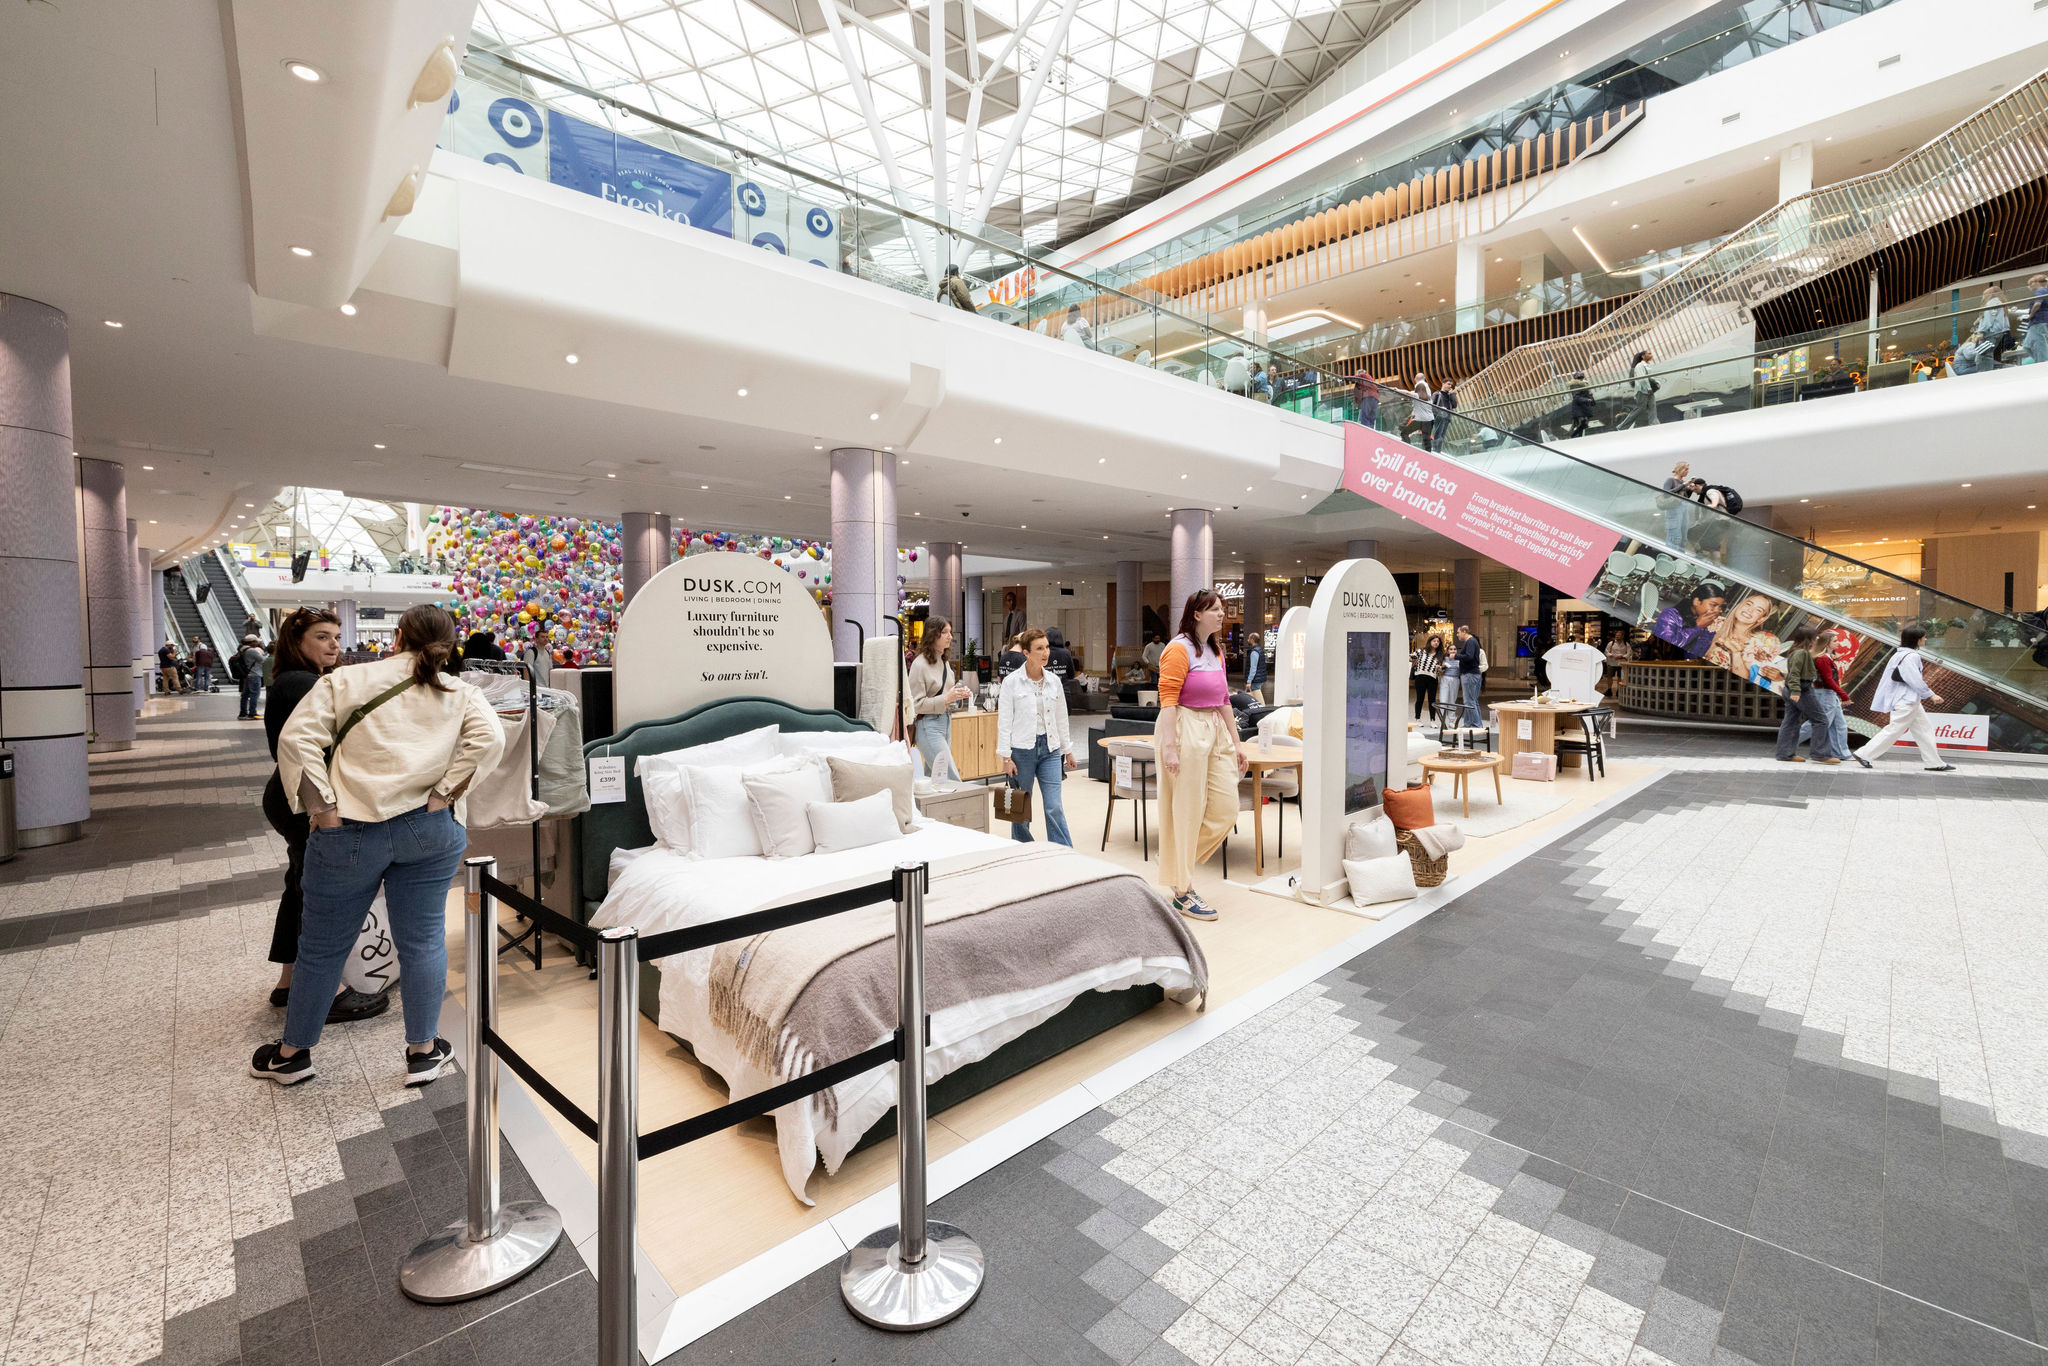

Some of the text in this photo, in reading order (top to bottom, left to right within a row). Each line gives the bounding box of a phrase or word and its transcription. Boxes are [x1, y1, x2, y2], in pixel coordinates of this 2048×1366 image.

[601, 182, 691, 227] Fresko
[1371, 447, 1458, 496] Spill the tea
[1361, 471, 1447, 520] over brunch.
[1471, 491, 1593, 550] From breakfast burritos to salt beef
[1461, 512, 1495, 532] everyone's
[1494, 526, 1513, 541] taste.
[1514, 534, 1528, 548] Get
[1527, 541, 1559, 561] together
[1558, 554, 1572, 567] IRL.
[1466, 501, 1585, 561] bagels, there's something to satisfy
[683, 578, 781, 594] DUSK.COM
[1215, 582, 1244, 599] Kieh
[1343, 591, 1395, 609] DUSK.COM
[687, 611, 779, 623] Luxury furniture
[693, 625, 746, 636] shouldn't
[748, 626, 761, 636] be
[706, 640, 763, 653] expensive.
[700, 669, 768, 682] So ours isn't.
[1934, 724, 1978, 739] tfield
